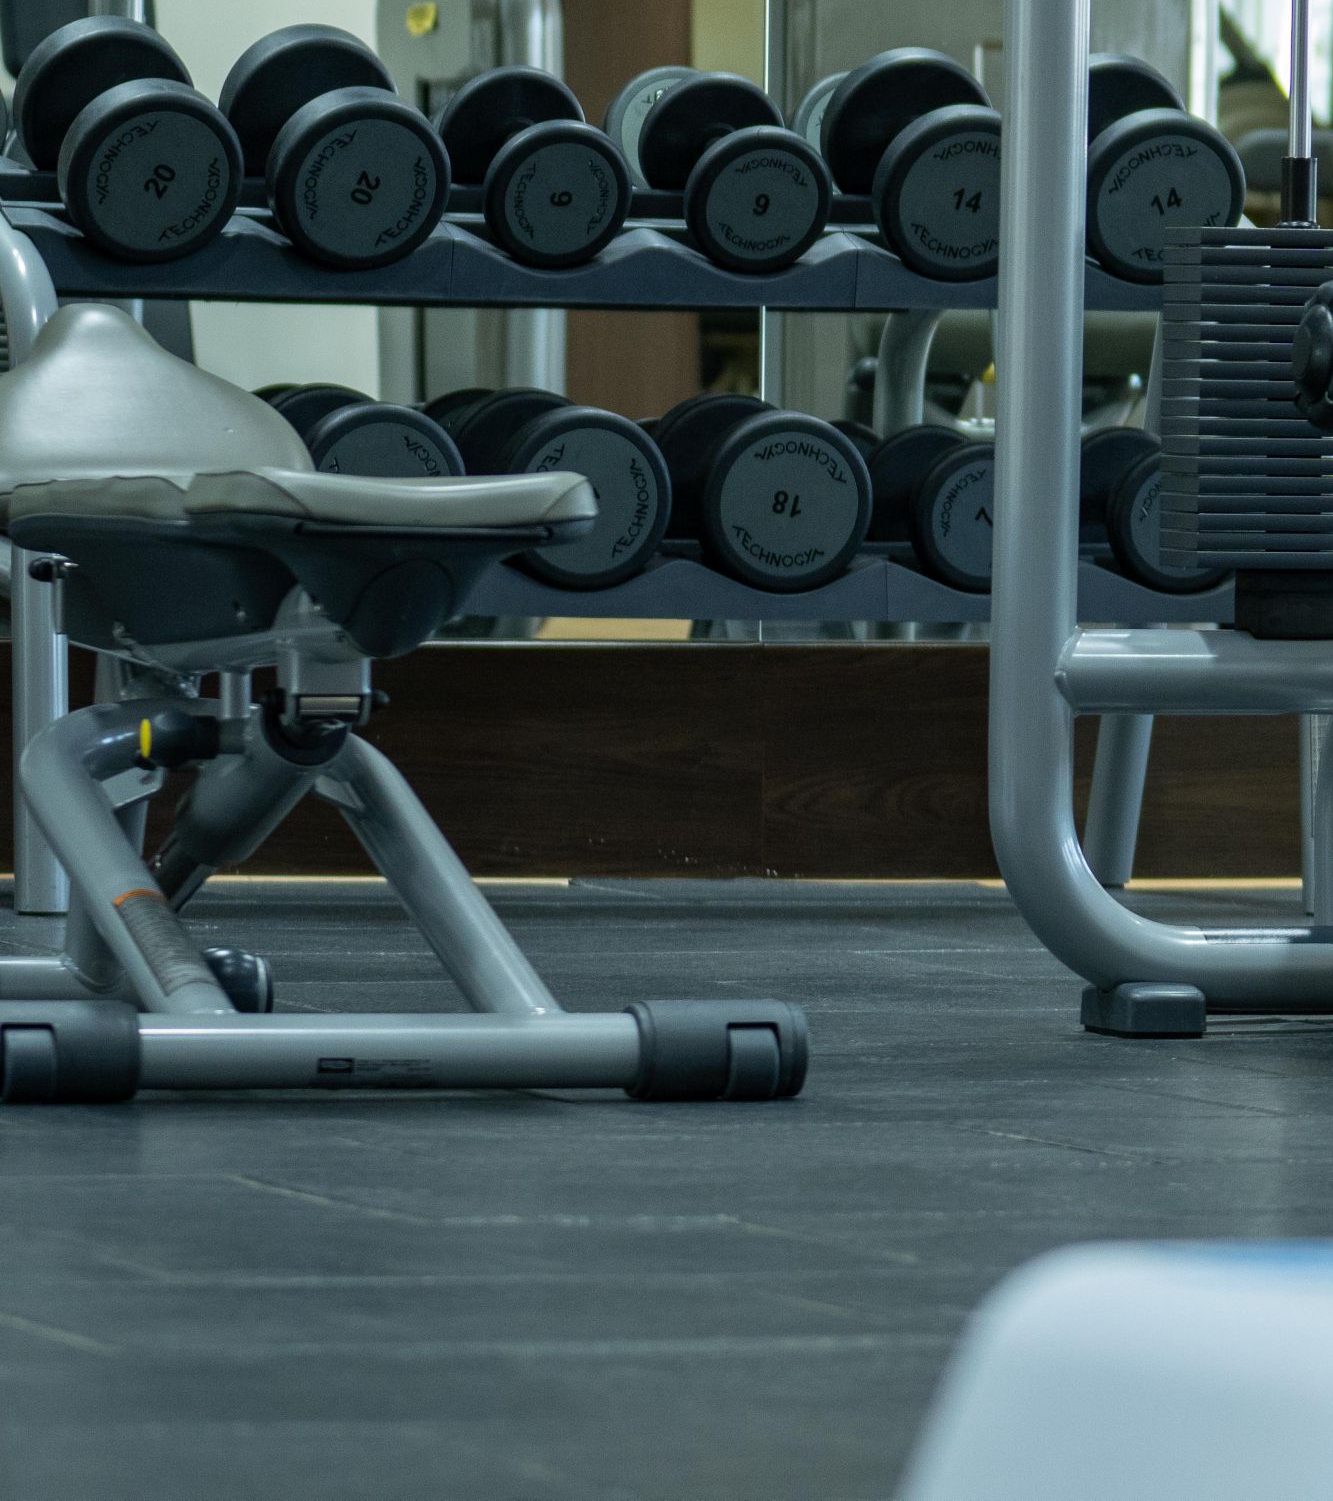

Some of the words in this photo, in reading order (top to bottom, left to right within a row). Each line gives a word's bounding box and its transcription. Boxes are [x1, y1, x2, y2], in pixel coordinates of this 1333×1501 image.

[143, 163, 176, 200] 20
[351, 170, 381, 205] 20
[953, 187, 982, 213] 14
[1150, 186, 1183, 216] 14
[772, 490, 801, 518] 18
